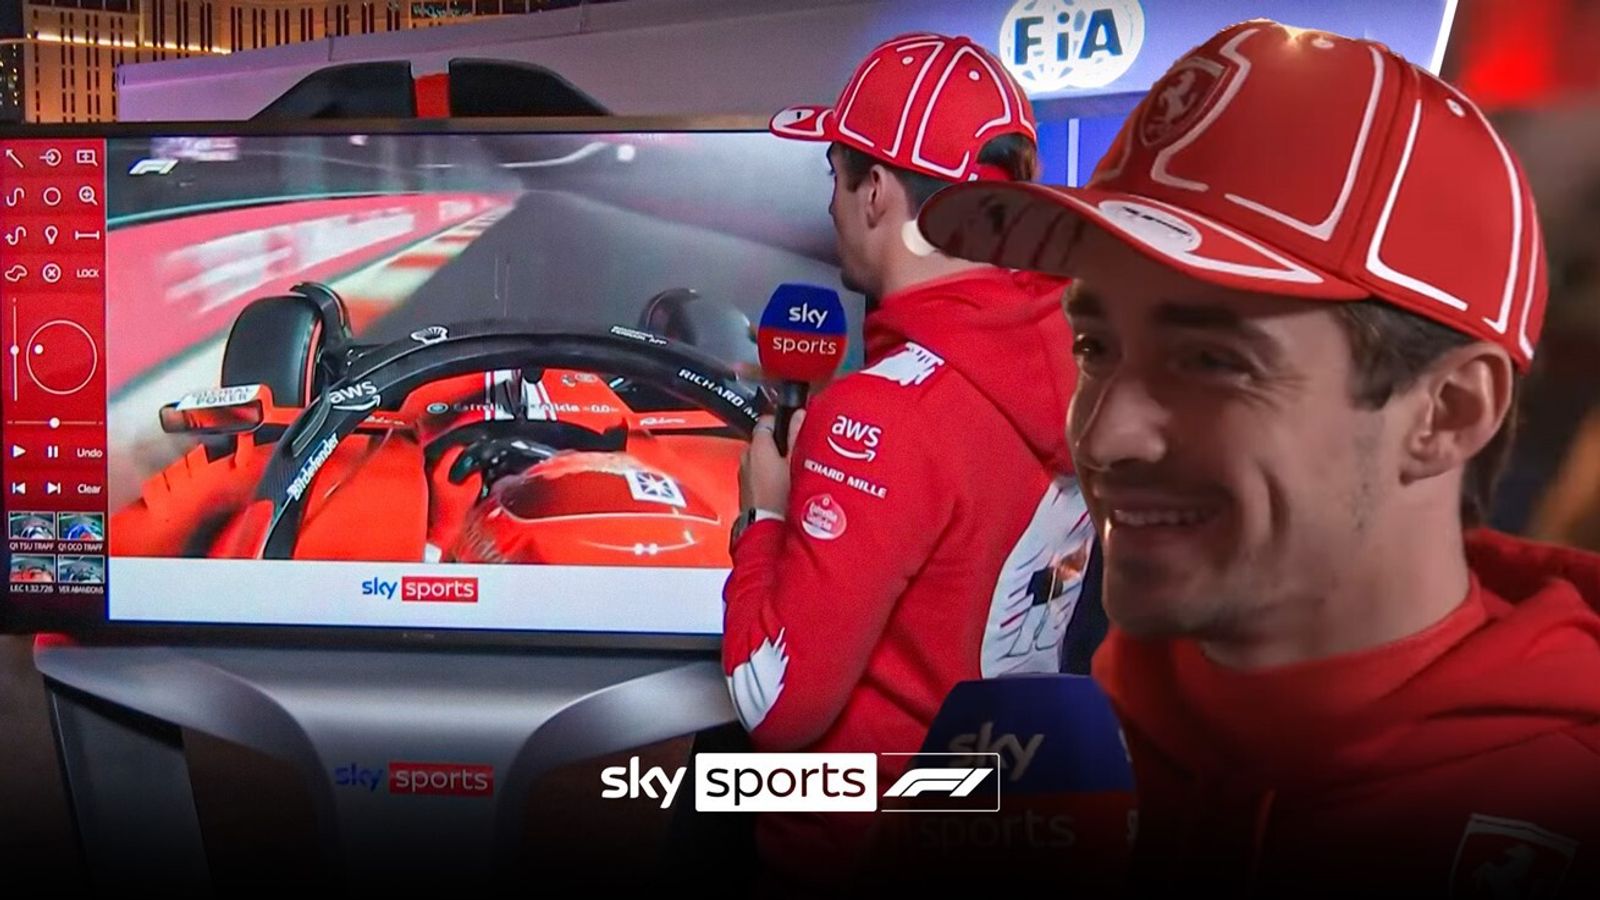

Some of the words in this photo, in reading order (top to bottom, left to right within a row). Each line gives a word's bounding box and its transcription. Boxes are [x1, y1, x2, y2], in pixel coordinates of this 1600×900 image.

[76, 269, 99, 278] LOCK
[788, 303, 828, 329] sky
[772, 336, 837, 355] sports
[329, 380, 378, 404] aws
[678, 368, 745, 408] RICHARD
[831, 415, 882, 448] aws
[77, 448, 103, 458] Undo
[77, 484, 102, 494] Clear
[846, 475, 888, 500] MILLE
[362, 577, 398, 599] sky
[405, 580, 474, 600] sports
[948, 721, 1045, 782] sky
[335, 762, 384, 792] sky
[396, 768, 489, 793] sports
